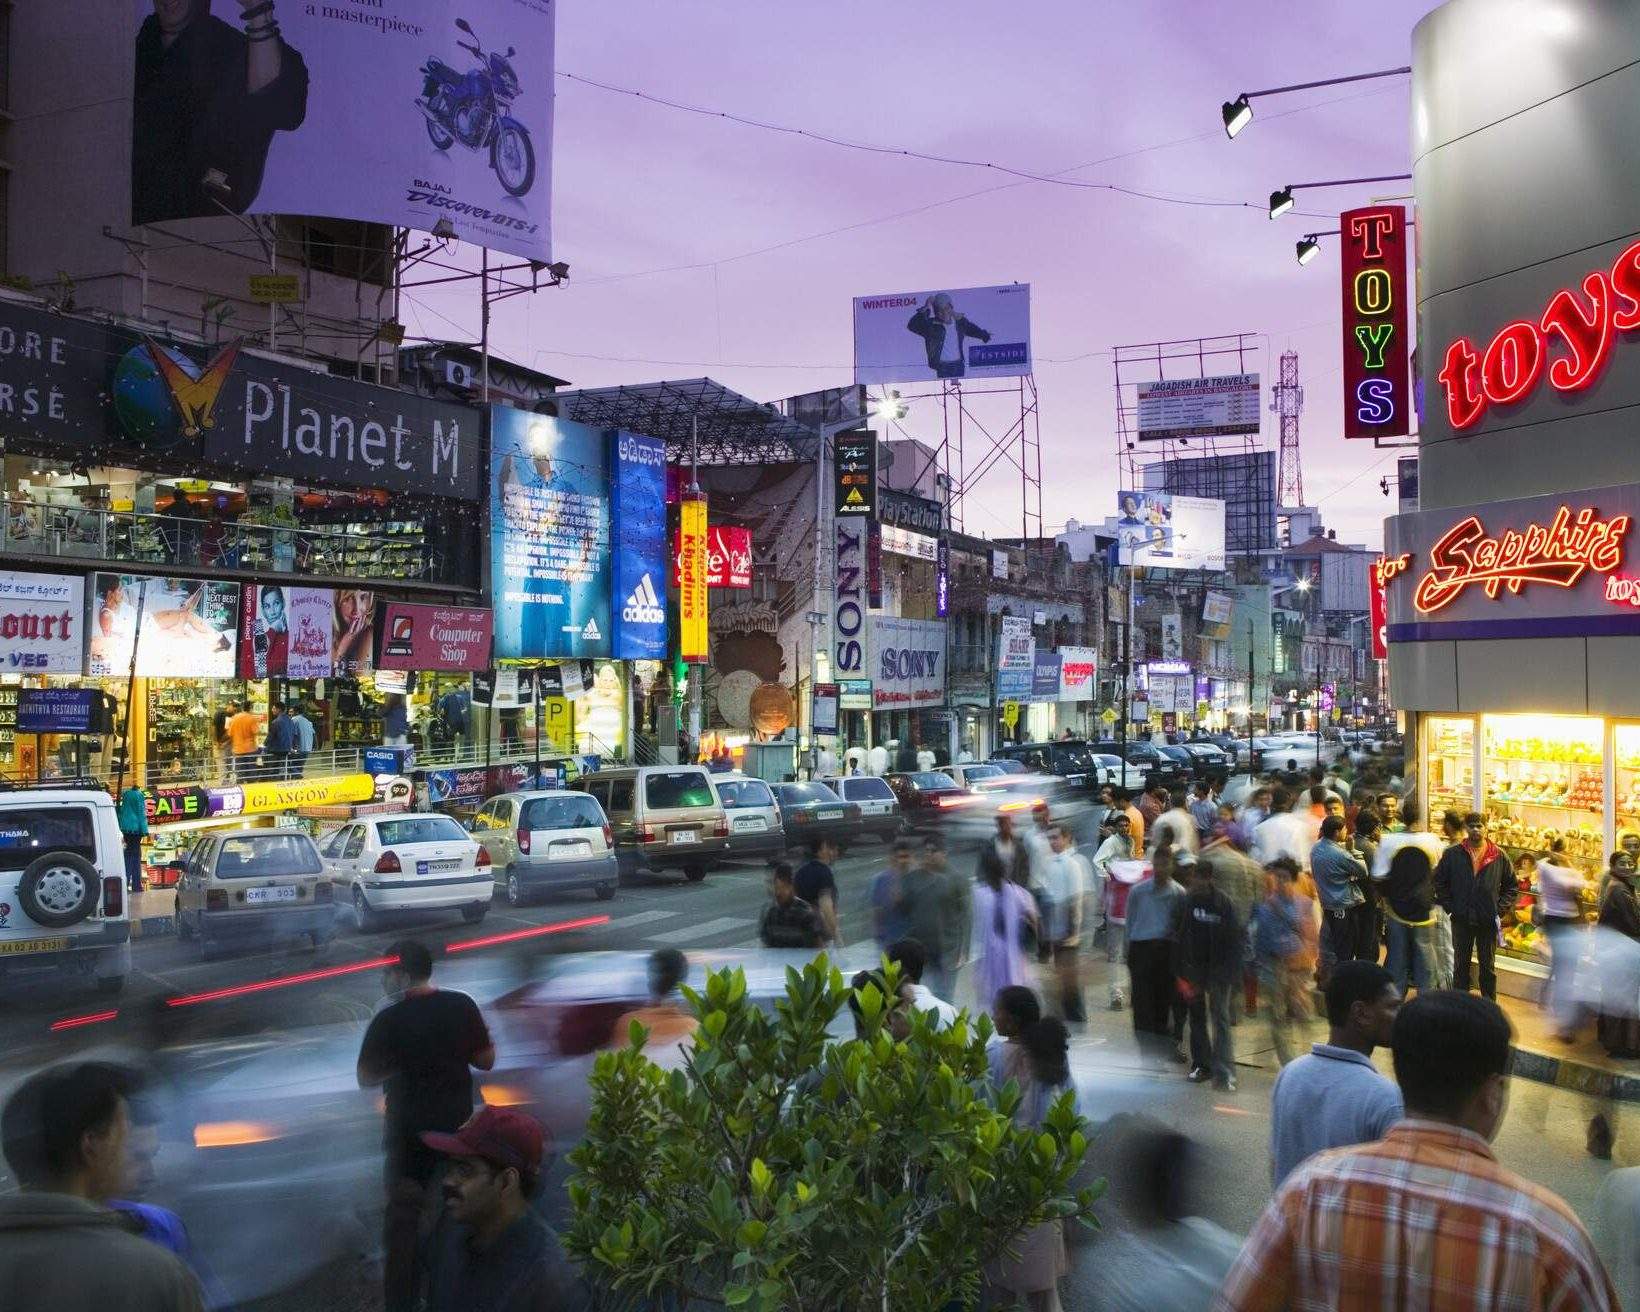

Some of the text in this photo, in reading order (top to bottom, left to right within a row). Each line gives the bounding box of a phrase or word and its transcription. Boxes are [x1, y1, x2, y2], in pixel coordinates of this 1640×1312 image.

[305, 6, 425, 37] a masterpiece
[413, 179, 452, 195] BAJAJ
[1351, 213, 1394, 424] TOYS
[1212, 375, 1251, 387] TRAVELS
[245, 380, 460, 478] Planet M
[1414, 507, 1628, 613] Sapphire
[683, 534, 697, 619] Khadim's
[836, 525, 862, 672] SONY
[622, 604, 665, 624] adidas
[429, 623, 483, 645] Computer
[10, 652, 49, 667] VEG
[440, 643, 467, 666] Shop
[881, 647, 940, 681] SONY
[551, 703, 563, 721] P
[366, 751, 394, 760] CASIO
[144, 795, 198, 816] SALE
[252, 788, 329, 807] GLASGOW
